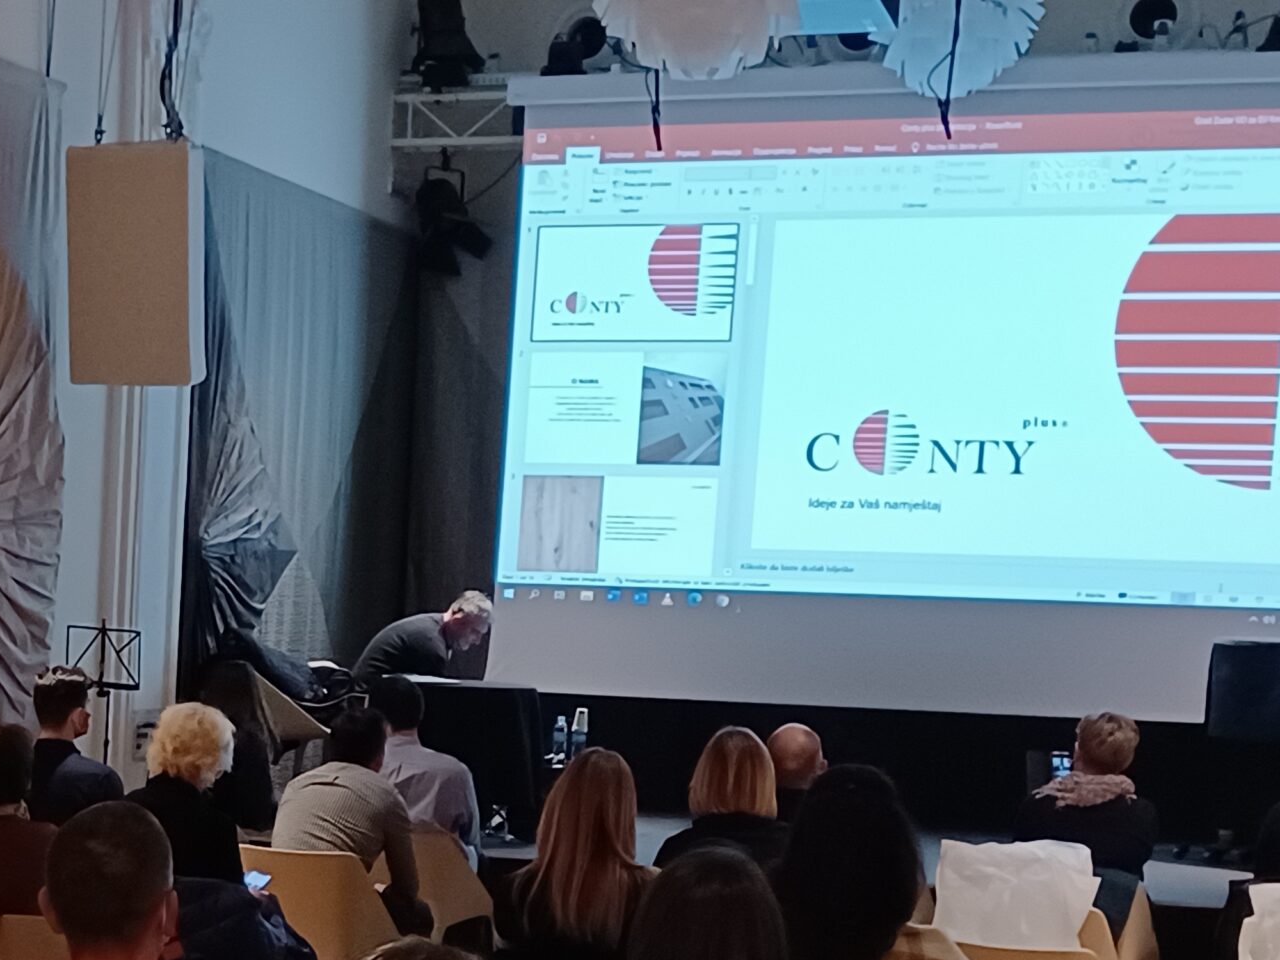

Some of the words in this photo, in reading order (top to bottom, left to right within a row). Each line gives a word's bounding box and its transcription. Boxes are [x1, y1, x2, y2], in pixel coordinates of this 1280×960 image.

[808, 497, 837, 511] Ideje
[840, 500, 855, 509] za
[858, 498, 880, 510] Vaš
[884, 499, 942, 513] namještaj
